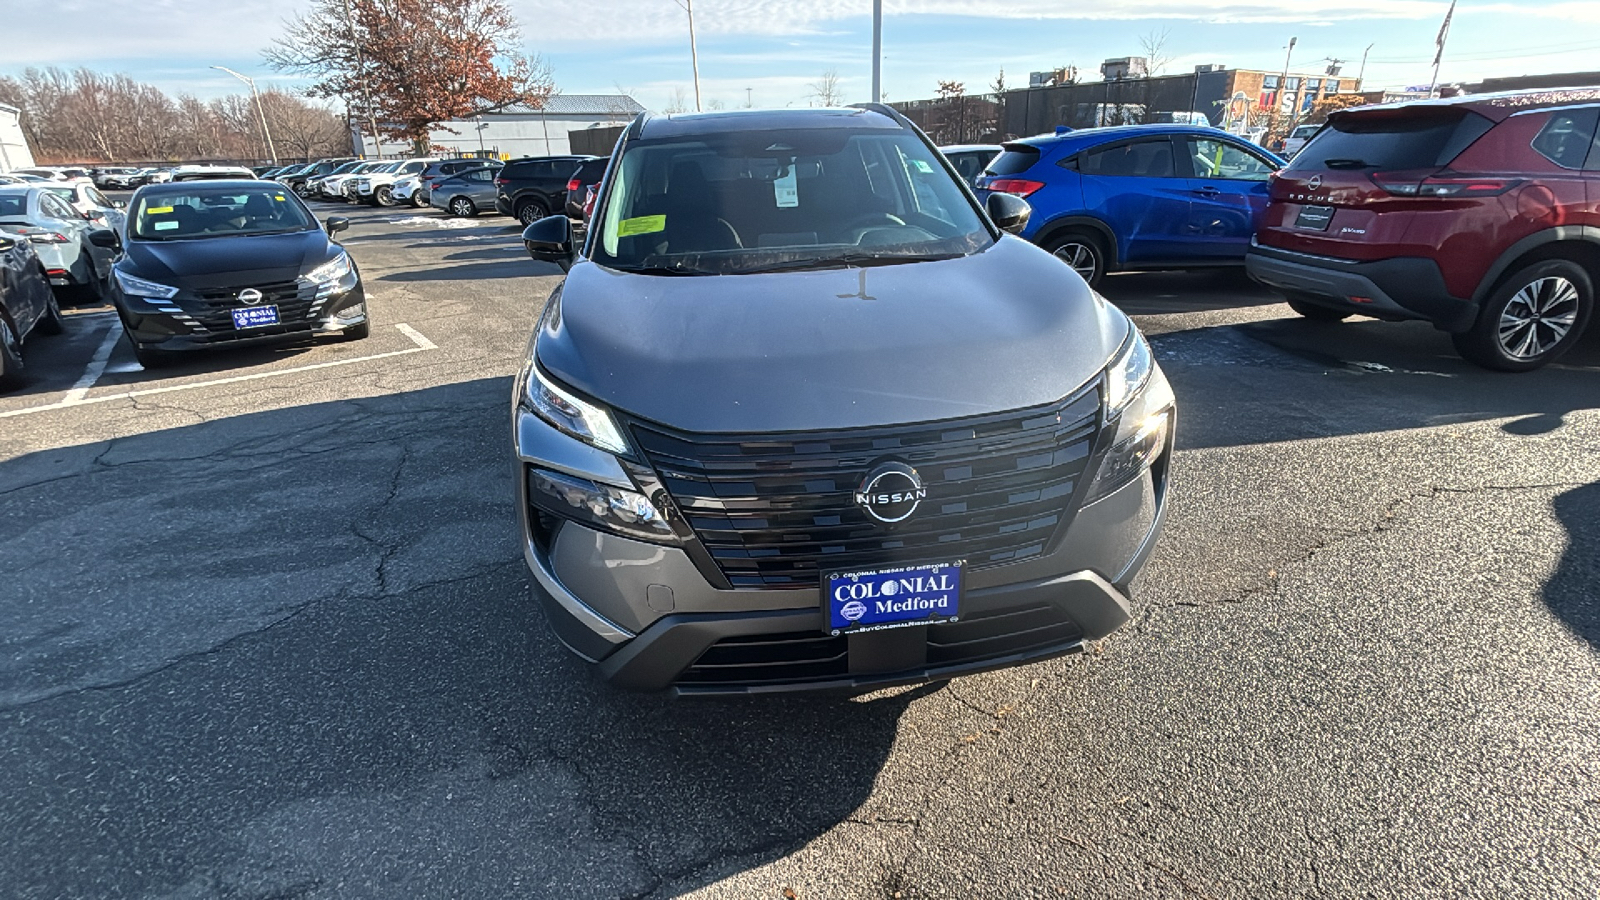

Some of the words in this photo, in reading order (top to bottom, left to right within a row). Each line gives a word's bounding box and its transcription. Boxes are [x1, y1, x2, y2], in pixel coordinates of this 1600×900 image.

[1289, 193, 1334, 202] ROGUE
[855, 488, 926, 504] NISSAN
[842, 569, 878, 578] COLONIAL
[916, 562, 950, 571] MEDFORD
[834, 574, 954, 602] COLONIAL
[875, 595, 948, 614] Medford
